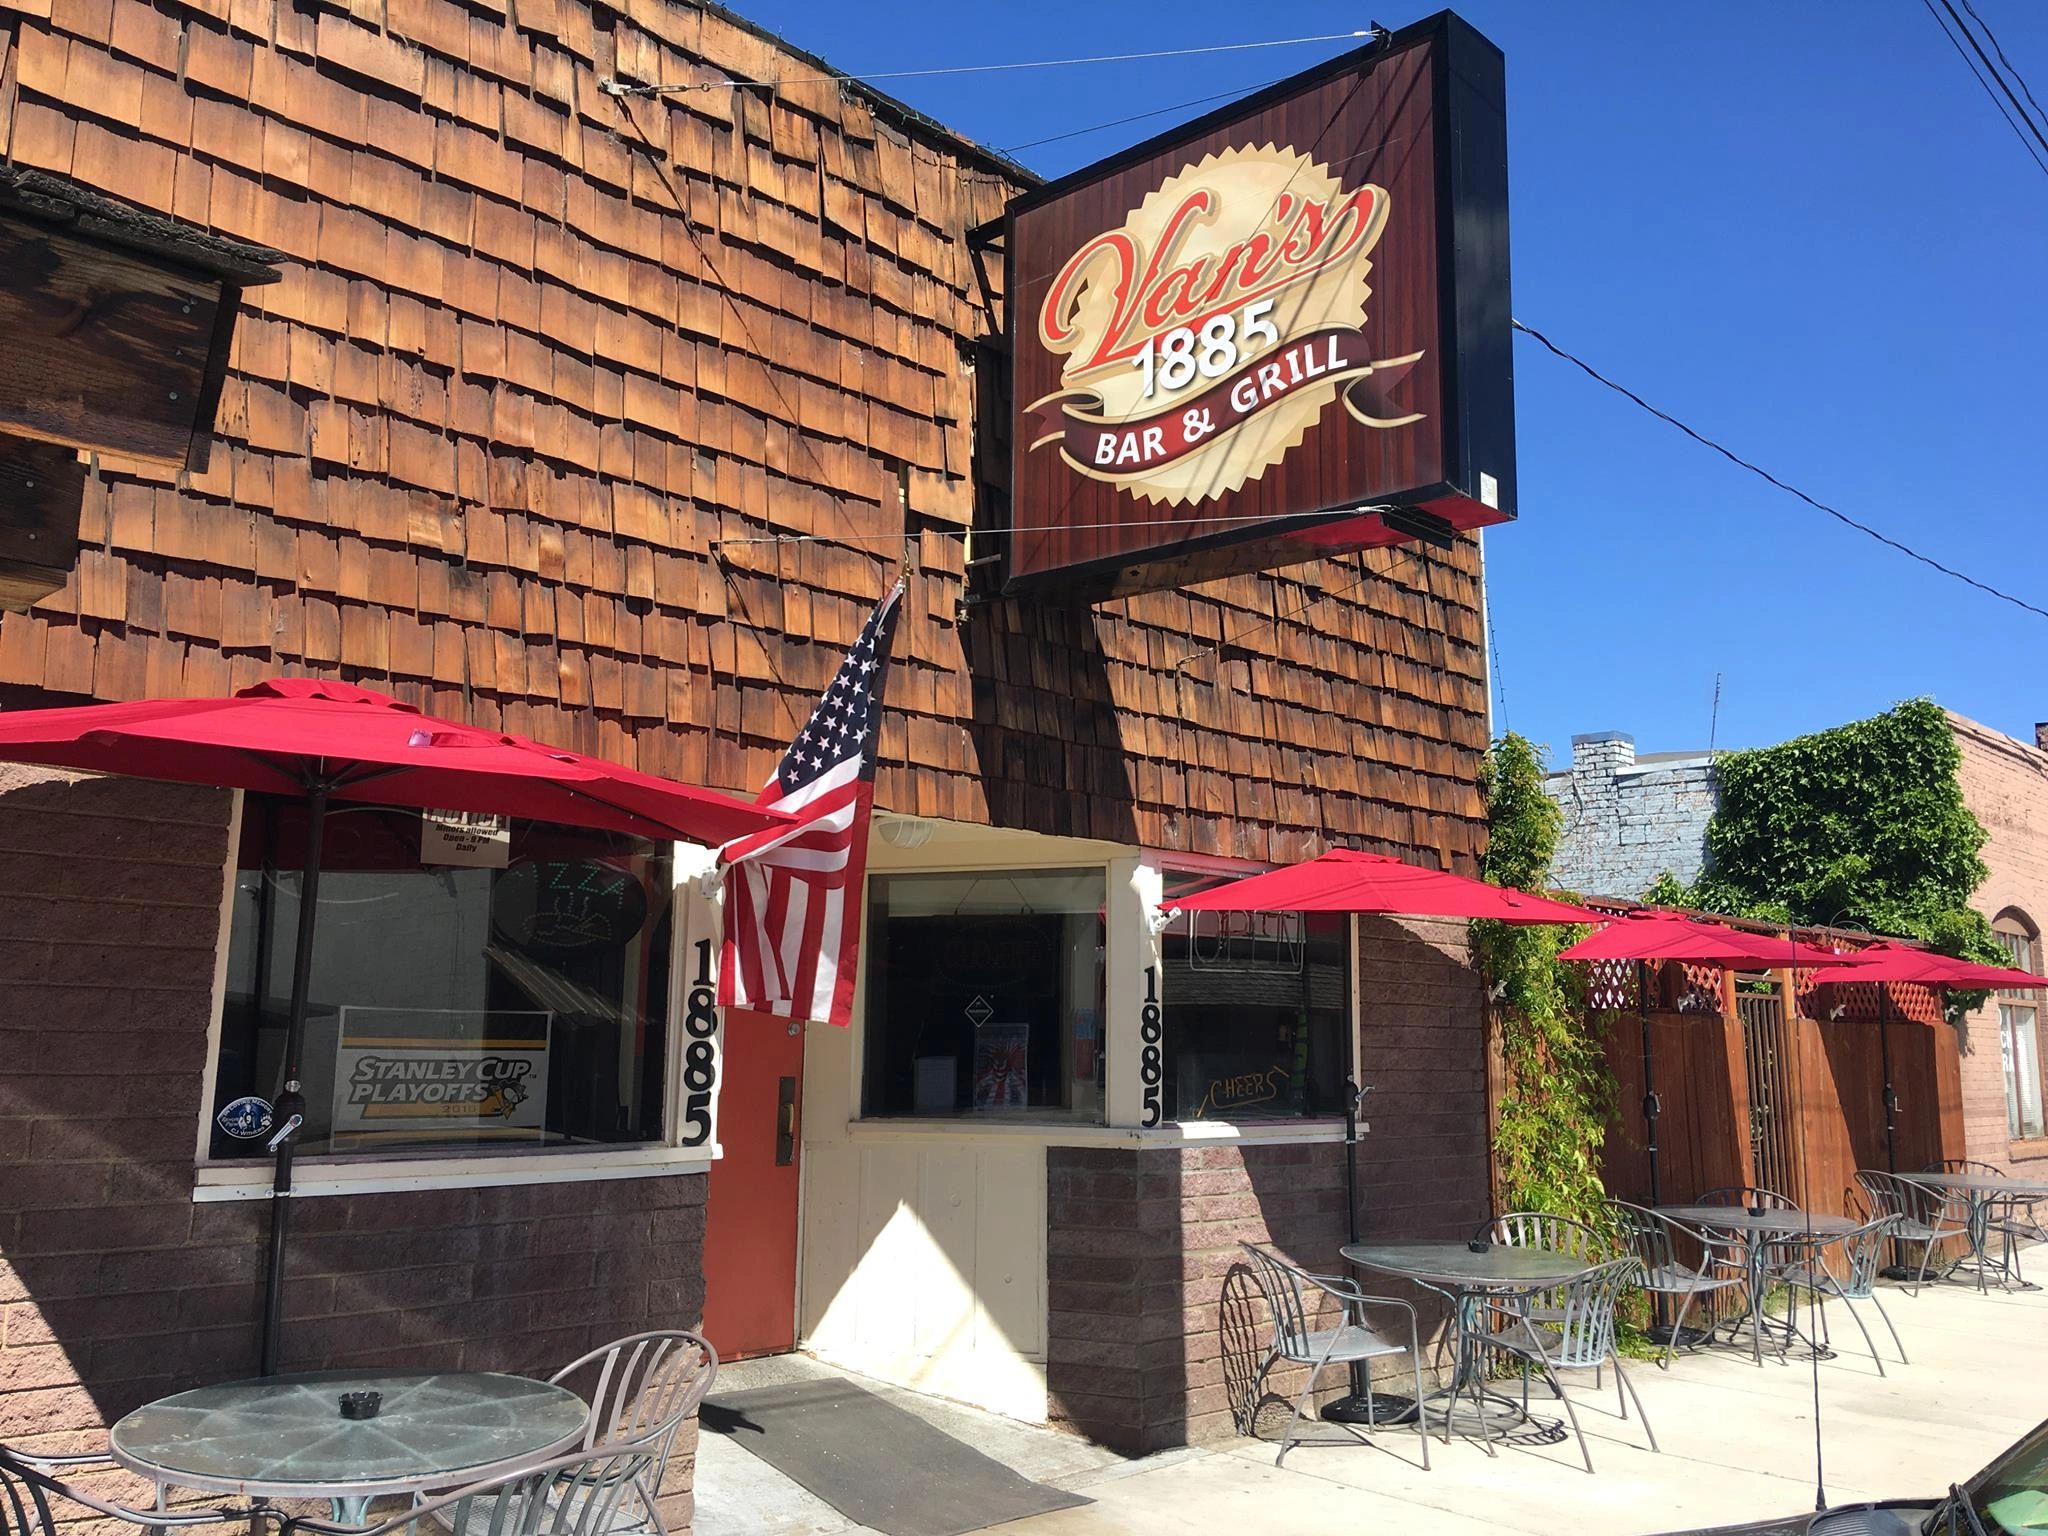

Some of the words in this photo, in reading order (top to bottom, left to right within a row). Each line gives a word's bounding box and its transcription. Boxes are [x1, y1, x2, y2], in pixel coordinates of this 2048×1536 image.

[1042, 188, 1380, 377] Van's
[1132, 299, 1278, 398] 1885
[1095, 420, 1167, 465] BAR
[1183, 408, 1216, 443] &
[1231, 335, 1348, 413] GRILL
[436, 823, 465, 833] Minors
[465, 825, 499, 836] allowed
[443, 833, 465, 843] Open
[477, 836, 491, 844] PM
[456, 843, 478, 853] Daily
[682, 938, 718, 1146] 1885
[1141, 966, 1162, 1128] 1885
[353, 1058, 474, 1081] STANLEY
[476, 1058, 530, 1081] CUP
[1210, 1068, 1278, 1109] CHEERS
[350, 1083, 489, 1102] PLAYOFFS
